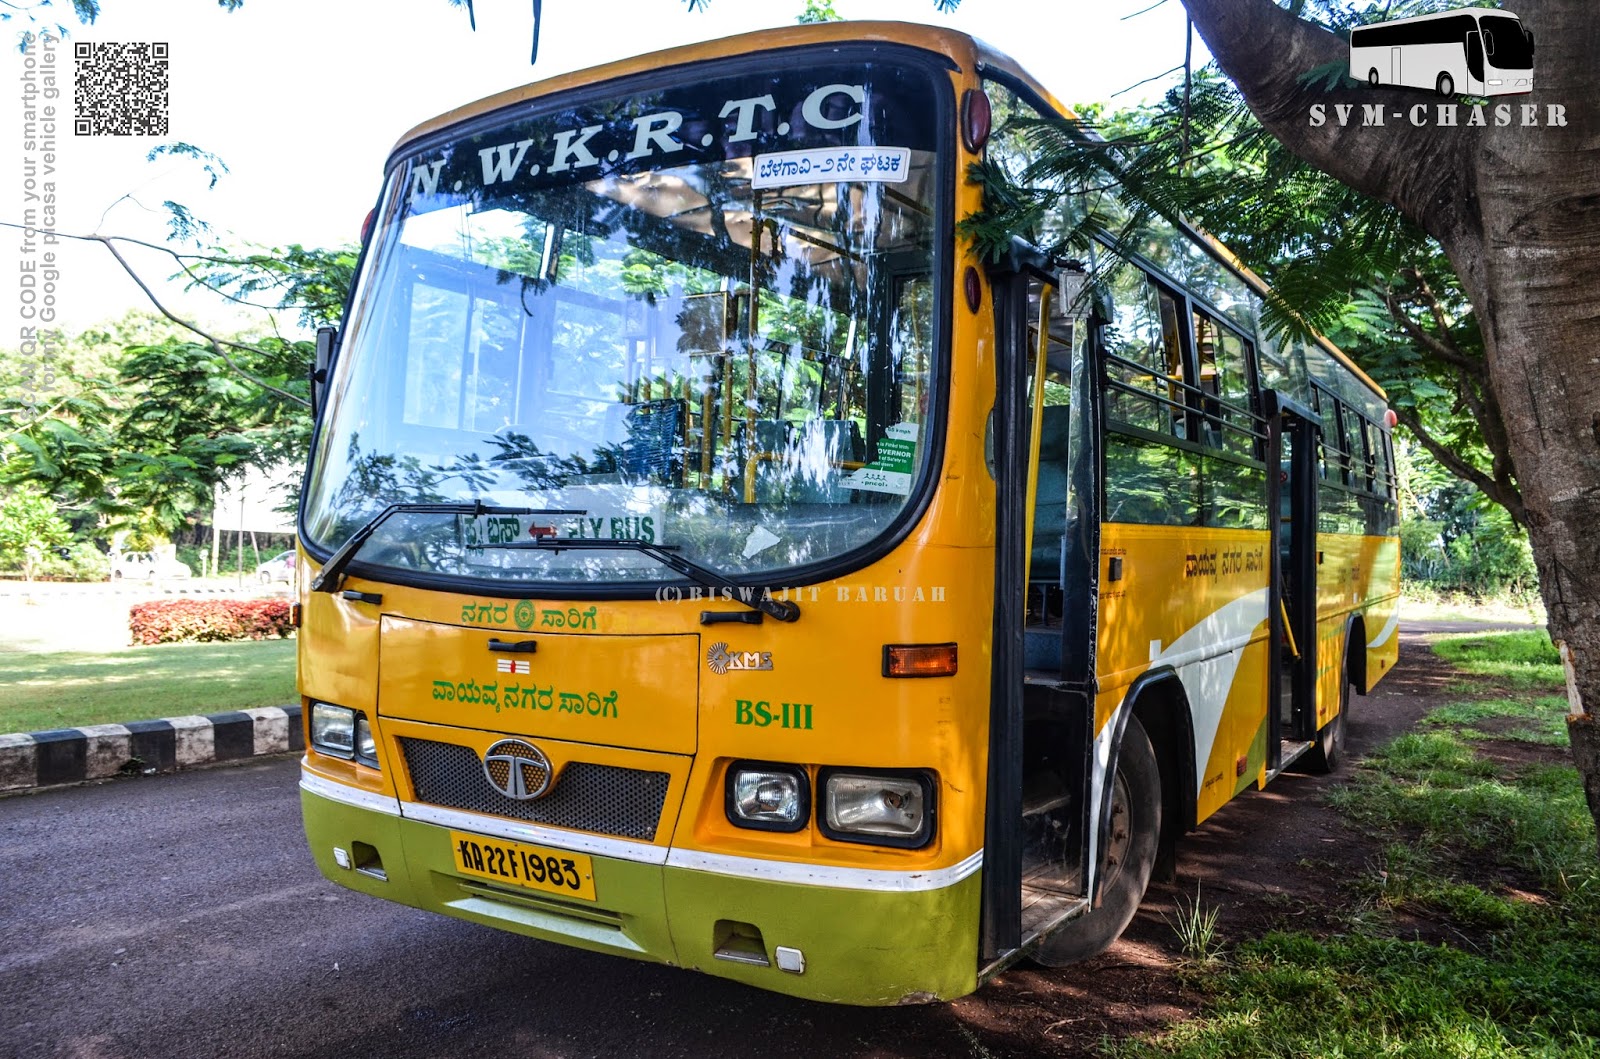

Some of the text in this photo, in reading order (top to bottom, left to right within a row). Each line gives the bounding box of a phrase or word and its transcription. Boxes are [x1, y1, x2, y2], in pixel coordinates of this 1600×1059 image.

[878, 448, 911, 458] OVERNOR
[610, 516, 655, 545] BUS
[461, 602, 508, 624] ನಗರ
[541, 605, 597, 630] ಸಾರಿಗೆ
[735, 699, 813, 730] BS-III
[459, 840, 581, 890] KA22F1983
